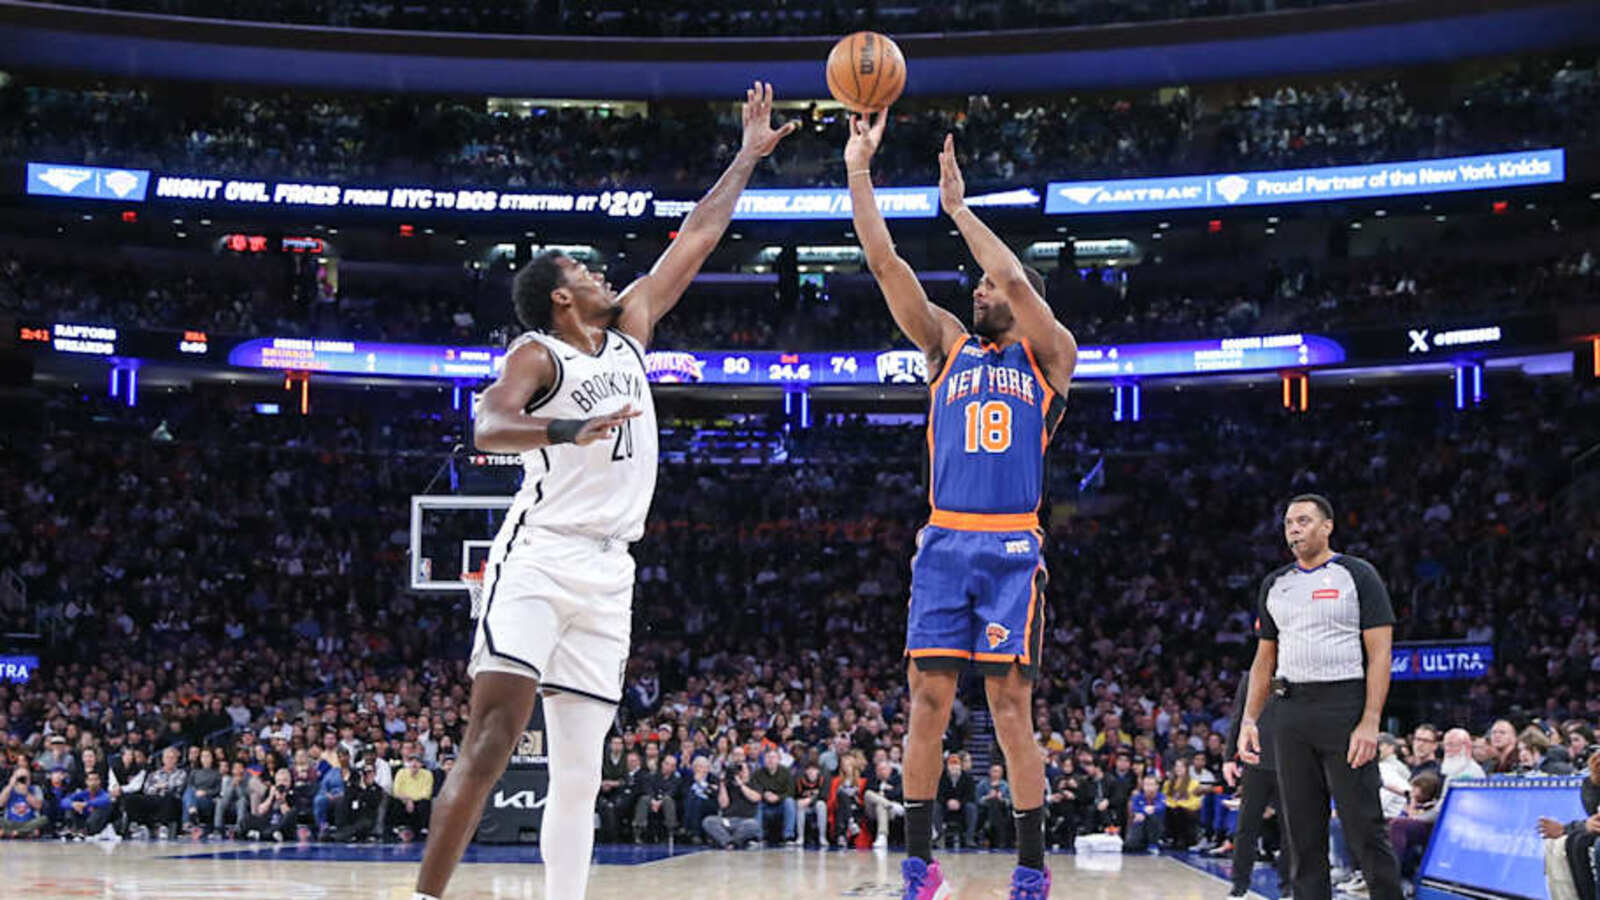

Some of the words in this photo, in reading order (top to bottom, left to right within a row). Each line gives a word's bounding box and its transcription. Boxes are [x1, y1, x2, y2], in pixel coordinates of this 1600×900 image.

[1257, 177, 1302, 195] Proud
[1306, 174, 1365, 192] Partner
[1369, 170, 1387, 187] of
[1390, 171, 1416, 187] the
[1419, 168, 1457, 184] New
[1459, 163, 1497, 181] York
[1500, 159, 1550, 176] Knicks
[157, 177, 222, 200] NIGHT
[224, 181, 270, 203] OWL
[273, 183, 341, 206] FARES
[343, 188, 389, 206] FROM
[391, 188, 434, 210] NYC
[434, 193, 456, 210] TO
[456, 190, 498, 211] BOS
[499, 194, 574, 212] STARTING
[575, 195, 598, 211] AT
[1097, 187, 1199, 203] AMTRAK
[54, 324, 117, 341] RAPTORS
[724, 358, 750, 374] 80
[769, 364, 811, 380] 24.6
[831, 357, 857, 374] 74
[876, 350, 928, 383] NETS
[571, 371, 643, 413] BROOKYN
[945, 365, 983, 406] NEW
[987, 364, 1034, 406] YORK
[965, 400, 1013, 453] 18
[486, 455, 522, 466] TISSO
[1422, 653, 1485, 672] ULTRA
